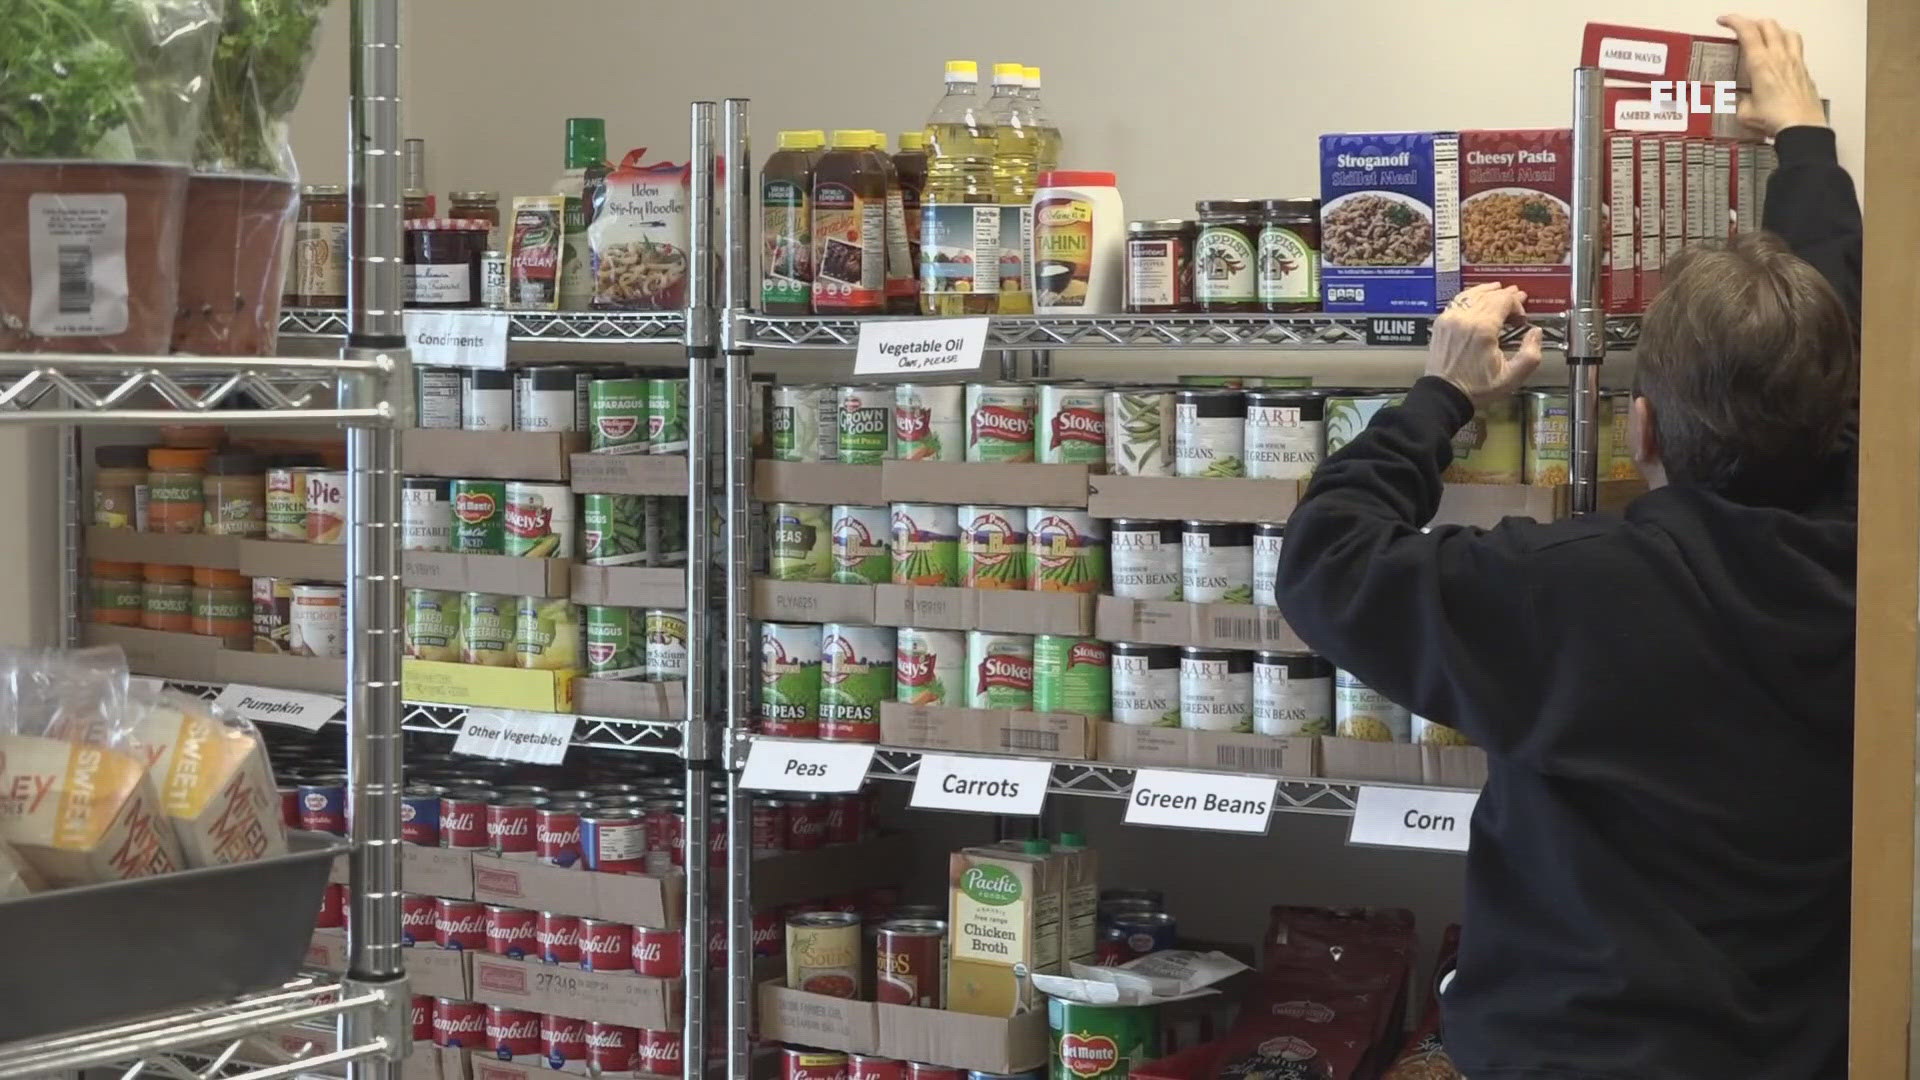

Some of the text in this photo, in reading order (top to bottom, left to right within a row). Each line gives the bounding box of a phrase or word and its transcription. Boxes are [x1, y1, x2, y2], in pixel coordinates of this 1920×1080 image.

[1604, 49, 1662, 65] AMBER WAVES
[1619, 110, 1683, 122] AMBER WAVES
[1337, 152, 1410, 171] Stroganoff
[1466, 150, 1556, 168] Cheesy Pasta
[1332, 170, 1417, 187] Skillet Meal
[1468, 168, 1555, 184] Skillet Meal
[631, 183, 659, 198] Udon
[1037, 235, 1087, 253] TAHINI
[512, 256, 552, 267] ITALIAN
[1373, 319, 1416, 335] ULINE
[878, 338, 964, 357] Vegetable Oil
[923, 354, 959, 367] PLEASE
[840, 409, 884, 431] GROWN
[848, 420, 884, 434] GOOD
[775, 529, 802, 544] PEAS
[1113, 532, 1160, 547] HART
[238, 697, 305, 716] Pumpkin
[772, 705, 806, 719] PEAS
[837, 706, 872, 720] PEAS
[468, 725, 564, 747] Other Vegetables
[783, 758, 828, 777] Peas
[942, 773, 1020, 799] Carrots
[1134, 787, 1267, 817] Green Beans
[1402, 808, 1456, 833] Corn
[966, 868, 1017, 893] Pacific
[963, 922, 1017, 942] Chicken
[971, 939, 1009, 956] Broth
[1077, 1045, 1113, 1059] Monte
